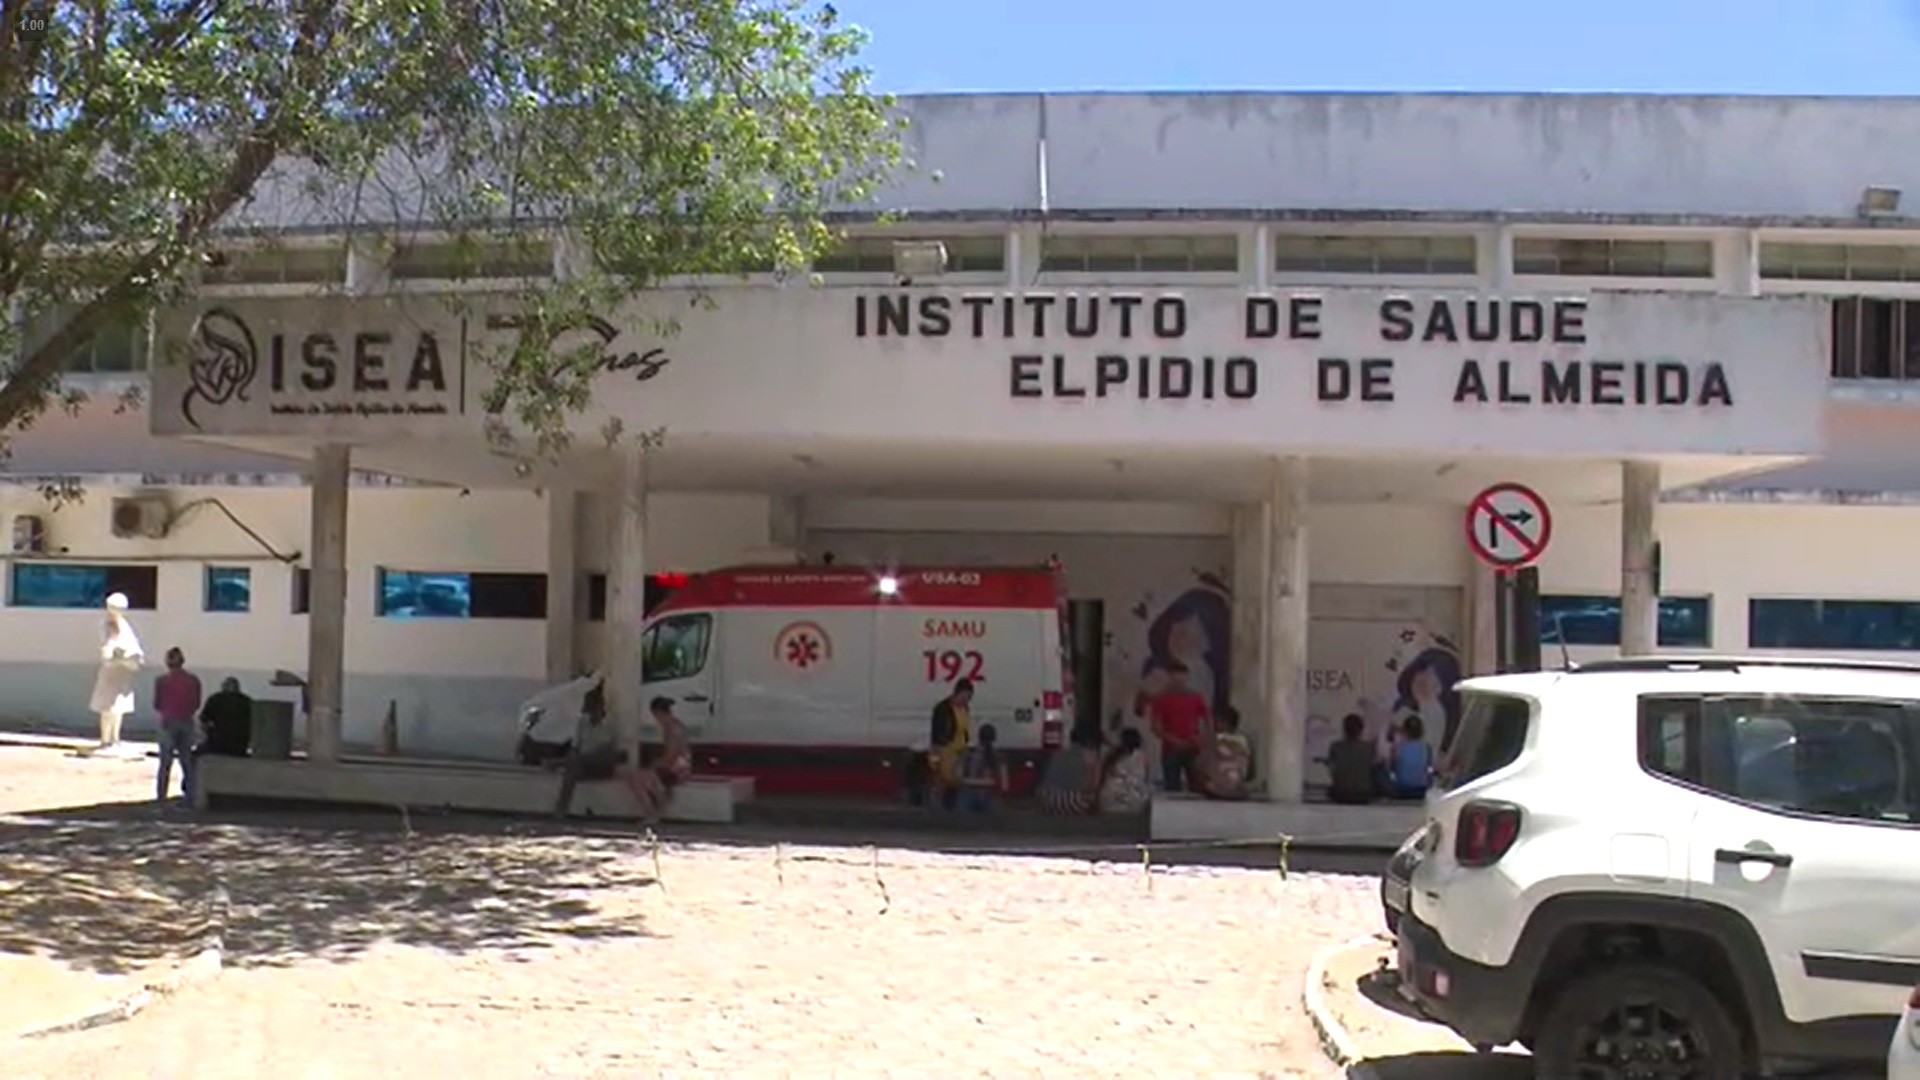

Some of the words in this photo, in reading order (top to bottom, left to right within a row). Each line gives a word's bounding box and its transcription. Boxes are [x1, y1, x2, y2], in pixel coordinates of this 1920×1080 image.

[856, 295, 1186, 338] INSTITUTO
[1245, 297, 1322, 340] DE
[1380, 299, 1588, 342] SAUDE
[271, 332, 446, 392] ISEA
[1010, 355, 1258, 399] ELPIDIO
[1318, 358, 1394, 401] DE
[1453, 360, 1733, 405] ALMEIDA
[923, 619, 986, 638] SAMU
[923, 650, 985, 682] 192
[1306, 669, 1354, 691] ISEA
